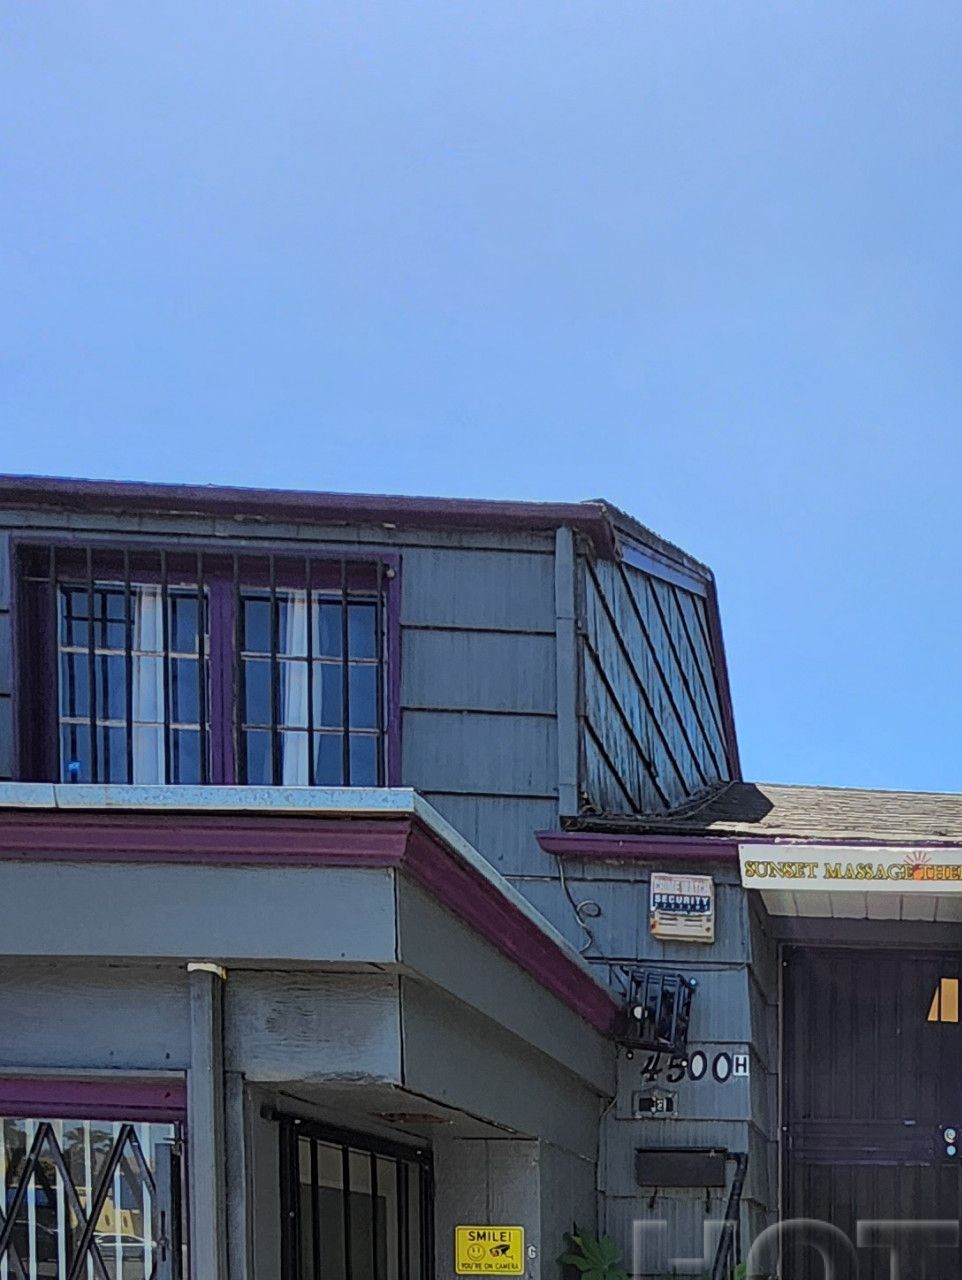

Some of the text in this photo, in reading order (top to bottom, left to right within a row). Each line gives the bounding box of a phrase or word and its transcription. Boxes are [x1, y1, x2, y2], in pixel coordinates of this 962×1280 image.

[744, 860, 818, 879] SUNSET
[823, 862, 914, 881] MASSAGE
[654, 893, 709, 906] SECURITY
[641, 1050, 732, 1084] 4500
[468, 1230, 512, 1243] SMILE!
[461, 1262, 519, 1271] YOU'RE ON CAMERA
